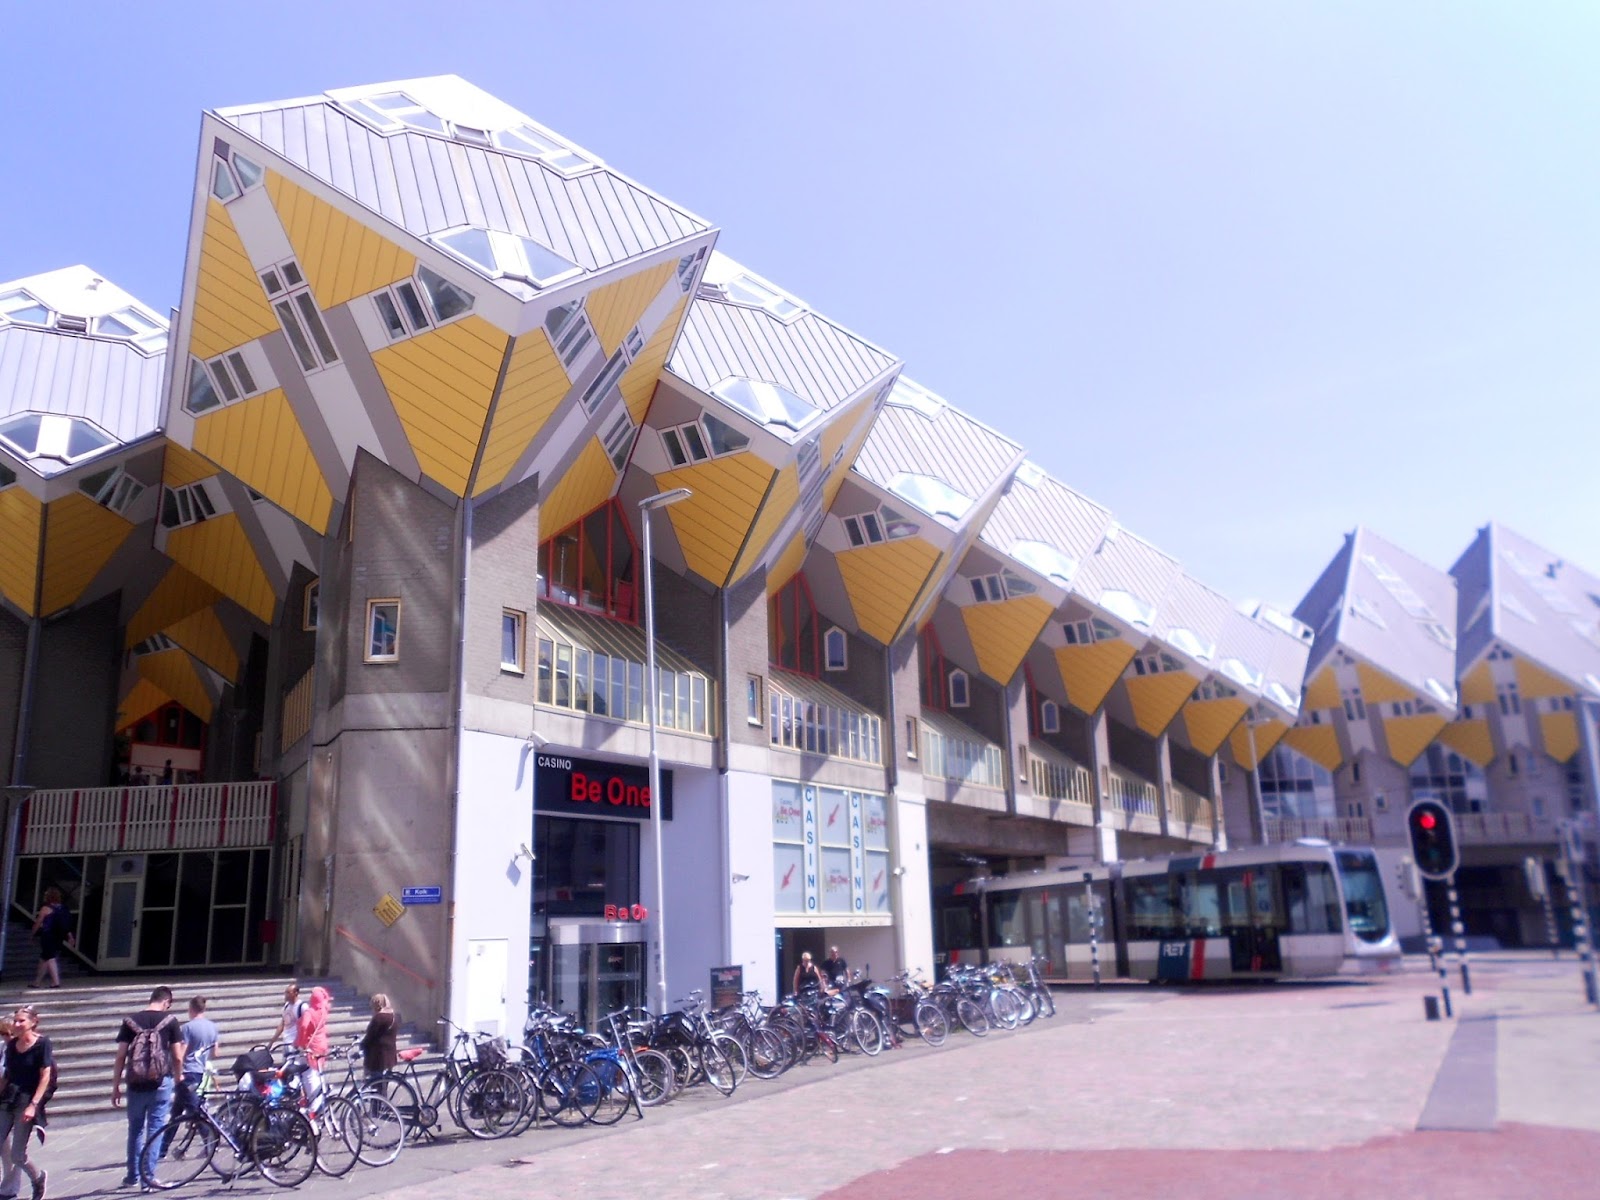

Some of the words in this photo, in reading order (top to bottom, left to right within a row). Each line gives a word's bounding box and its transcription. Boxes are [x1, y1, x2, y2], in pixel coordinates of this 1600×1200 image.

[538, 756, 572, 770] CASINO
[571, 772, 602, 803] Be
[607, 776, 653, 807] One
[804, 788, 816, 910] CASINO
[851, 796, 863, 911] CASINO
[604, 903, 629, 920] Be
[933, 952, 947, 964] ET
[1162, 942, 1186, 957] RET
